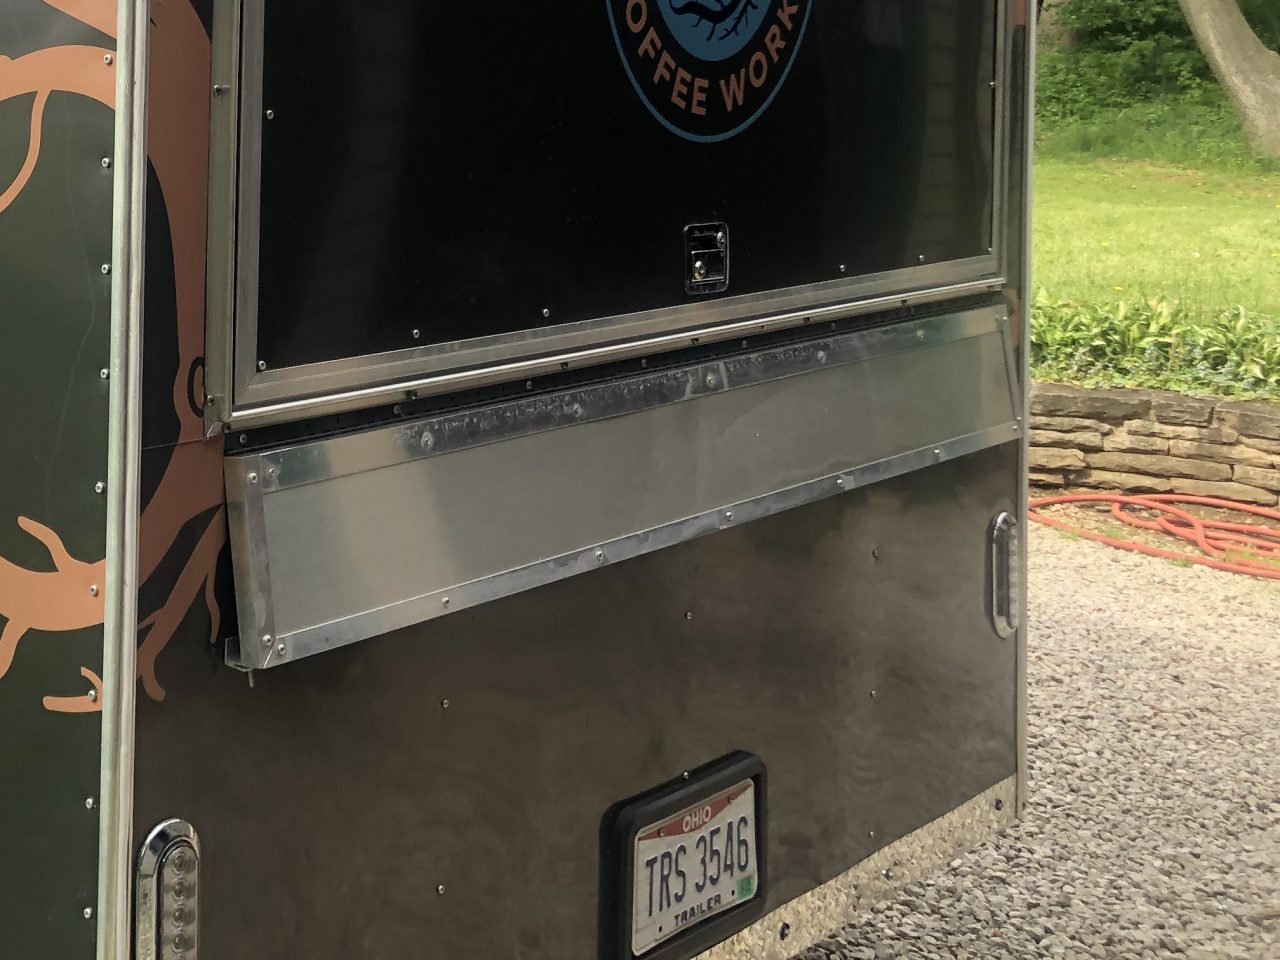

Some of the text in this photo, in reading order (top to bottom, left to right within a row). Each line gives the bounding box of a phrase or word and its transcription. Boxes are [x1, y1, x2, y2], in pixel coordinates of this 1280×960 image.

[682, 806, 713, 833] OHIO
[645, 815, 750, 918] TRS 3546
[673, 893, 723, 927] TRAILER
